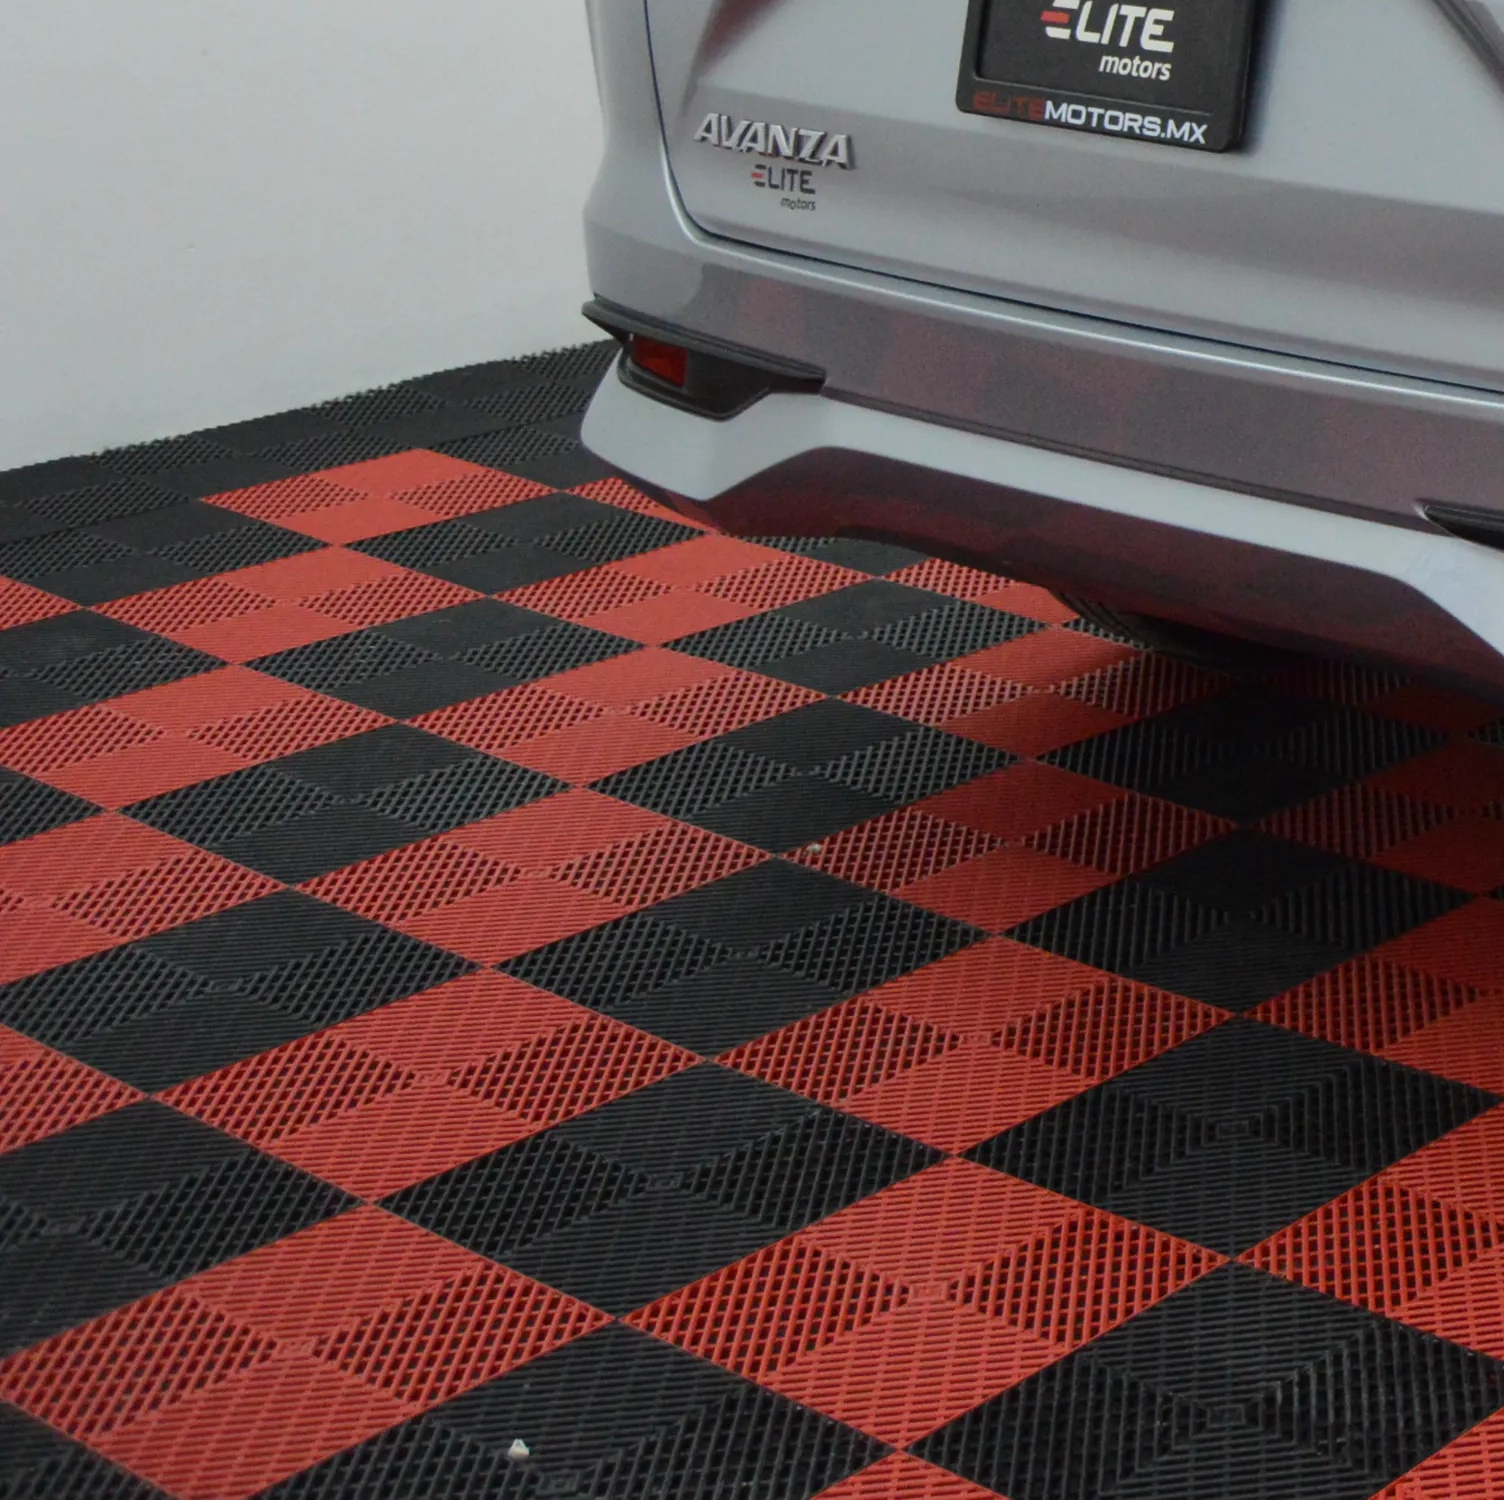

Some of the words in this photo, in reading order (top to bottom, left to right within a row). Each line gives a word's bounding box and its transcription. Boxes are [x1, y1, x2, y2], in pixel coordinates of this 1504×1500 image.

[1098, 53, 1172, 81] motors
[693, 112, 853, 169] AVANZA
[751, 163, 816, 195] ELITE
[780, 196, 817, 211] motors
